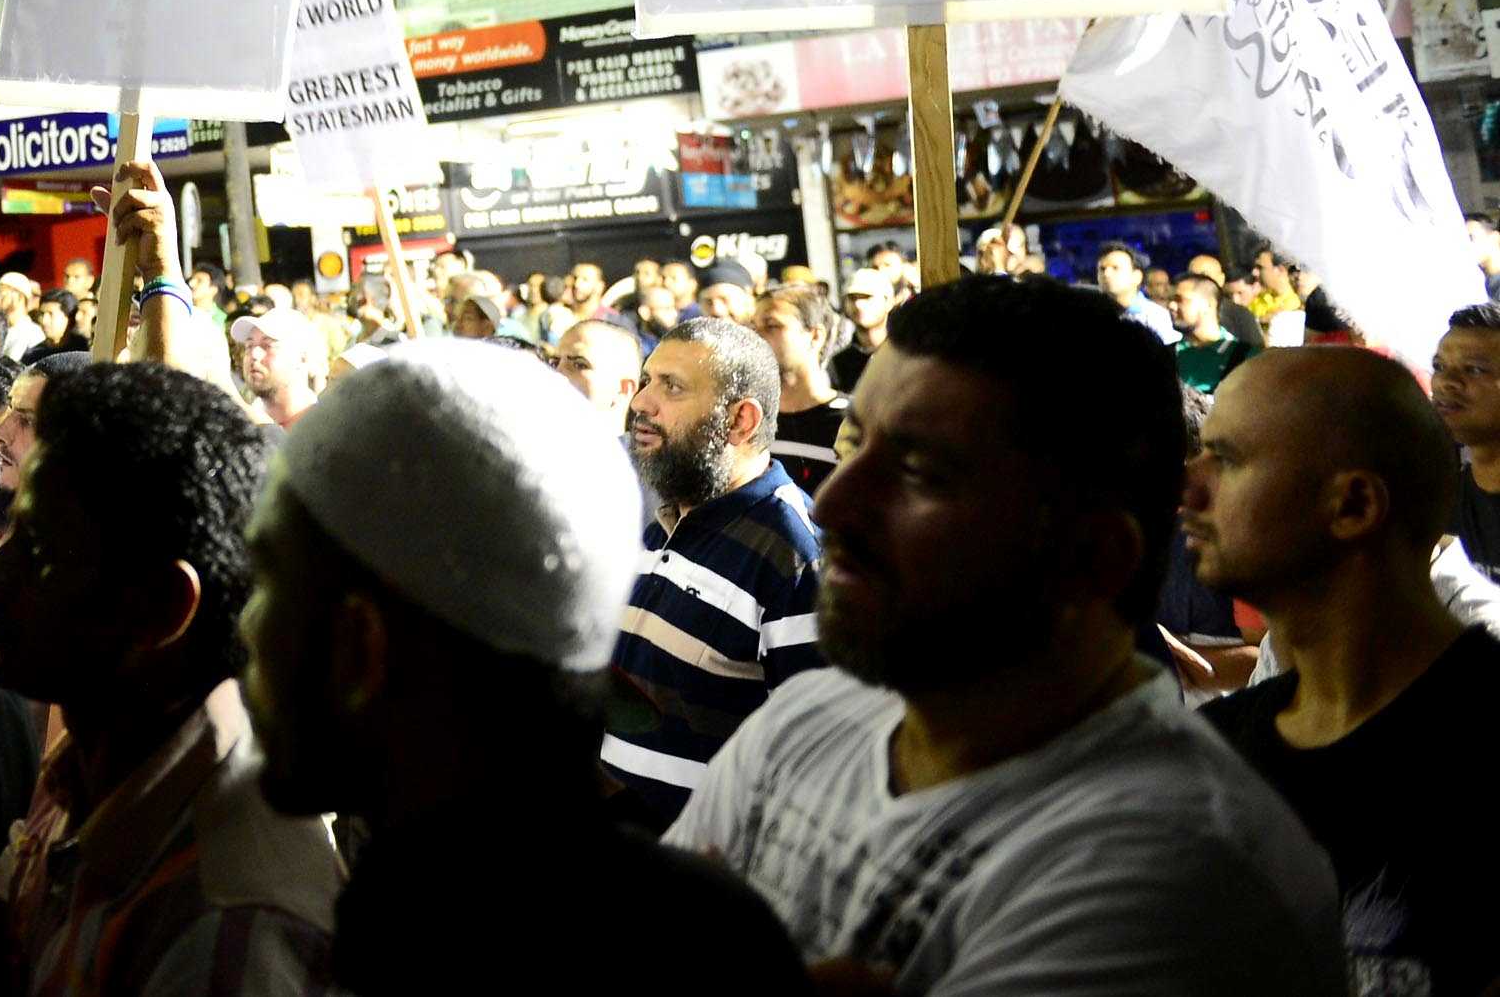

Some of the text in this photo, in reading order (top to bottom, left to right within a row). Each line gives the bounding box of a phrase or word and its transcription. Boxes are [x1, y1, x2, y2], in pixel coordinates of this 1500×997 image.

[288, 62, 401, 106] GREATEST
[437, 78, 503, 98] Tobacco
[293, 97, 414, 135] STATESMAN
[424, 87, 543, 115] ecialist & Gifts
